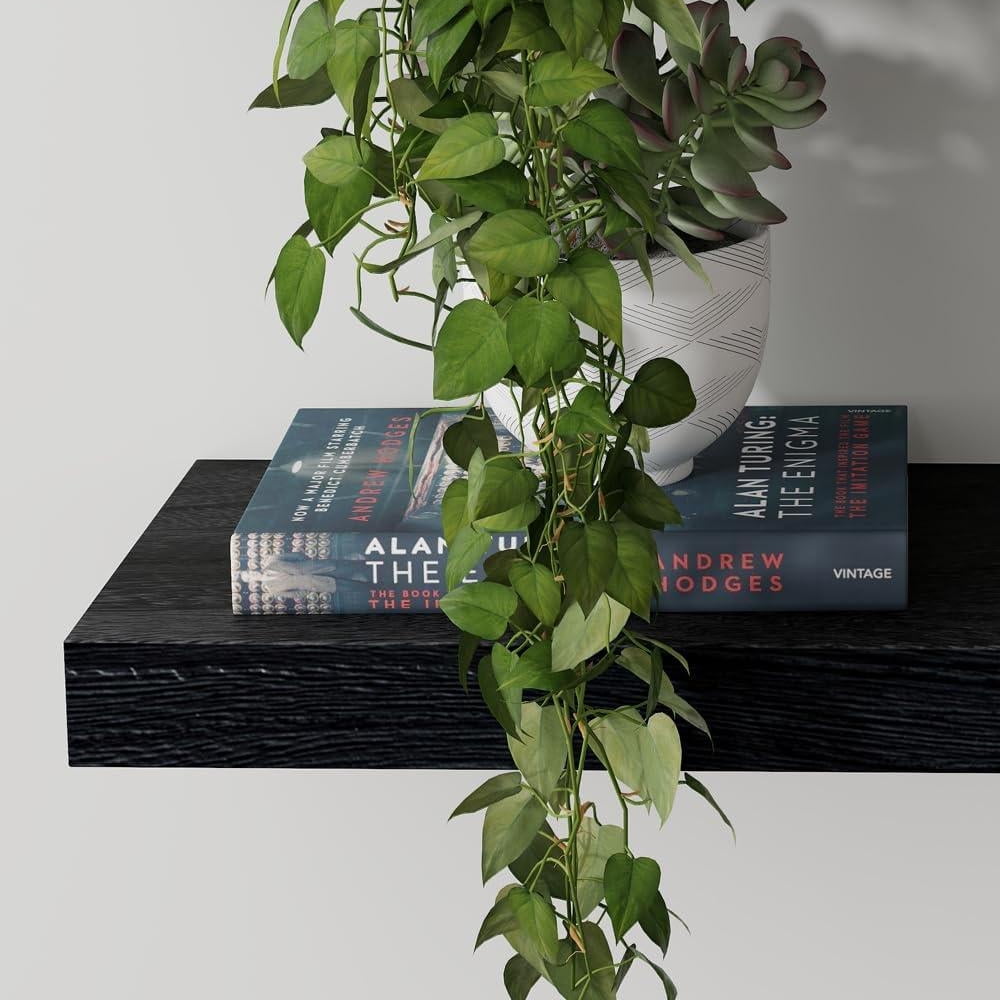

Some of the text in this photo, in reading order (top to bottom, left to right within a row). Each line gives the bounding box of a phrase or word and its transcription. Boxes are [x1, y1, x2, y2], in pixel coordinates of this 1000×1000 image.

[326, 416, 352, 450] STARRING
[314, 425, 366, 512] BENEDICT CUMBERBATCH
[318, 450, 336, 469] FILM
[348, 416, 412, 522] ANDREW HODGES
[732, 415, 777, 519] ALAN TURING:
[778, 415, 820, 520] THE ENIGMA
[848, 415, 870, 518] THE IMITATION GAME
[304, 470, 327, 495] MAJOR
[291, 504, 310, 522] NOW
[365, 560, 441, 584] THE
[833, 567, 893, 579] VINTAGE
[368, 599, 411, 609] THE
[369, 589, 440, 598] THE BOOK
